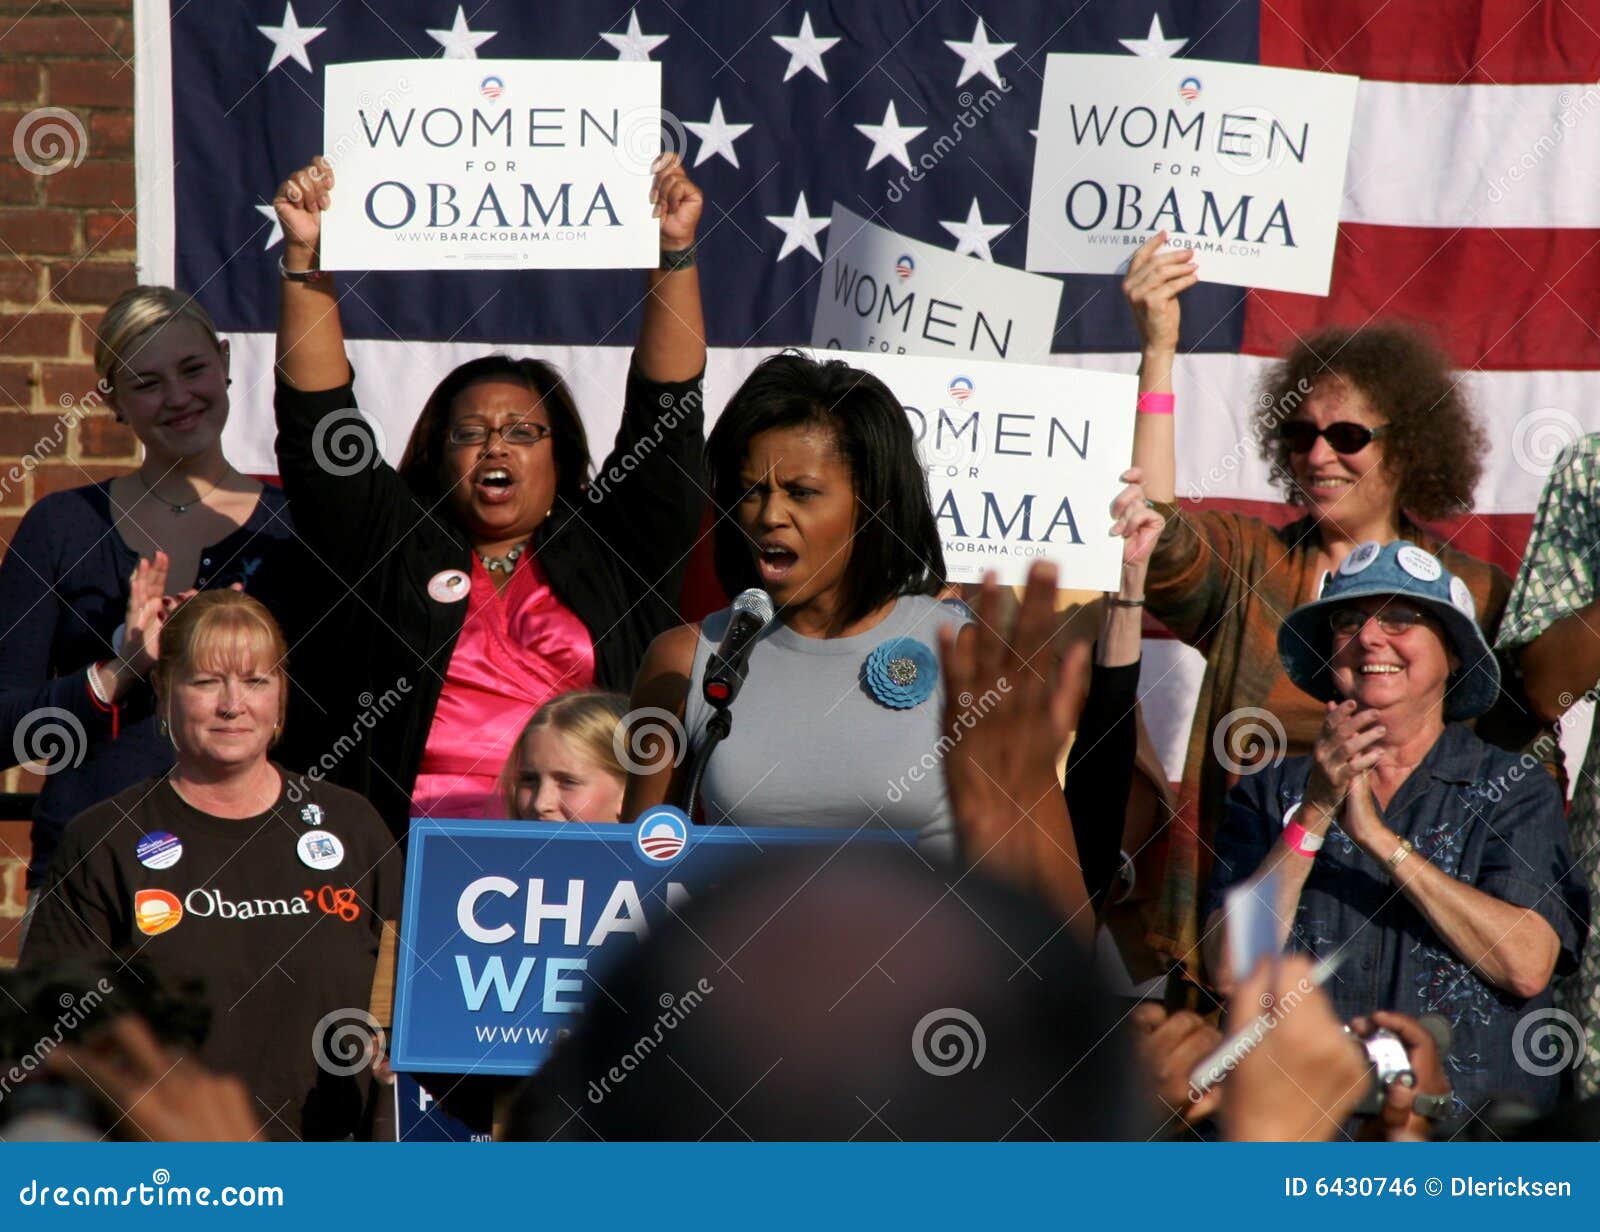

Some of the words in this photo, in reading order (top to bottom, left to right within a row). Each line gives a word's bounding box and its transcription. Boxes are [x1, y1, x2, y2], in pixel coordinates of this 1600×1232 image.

[358, 107, 619, 148] WOMEN
[1070, 104, 1309, 163] WOMEN
[466, 161, 517, 172] FOR
[1152, 162, 1201, 177] FOR
[364, 180, 624, 230] OBAMA
[1065, 180, 1298, 248] OBAMA
[394, 231, 587, 242] WWW.BARACKOBAMA.COM
[1087, 233, 1261, 257] WWW.BARKOBAMA.COM
[835, 258, 1013, 359] WOMEN
[903, 405, 1090, 460] OMEN
[927, 464, 979, 479] FOR
[935, 488, 1086, 545] AMA
[457, 876, 692, 946] CHA
[454, 955, 588, 1014] WE
